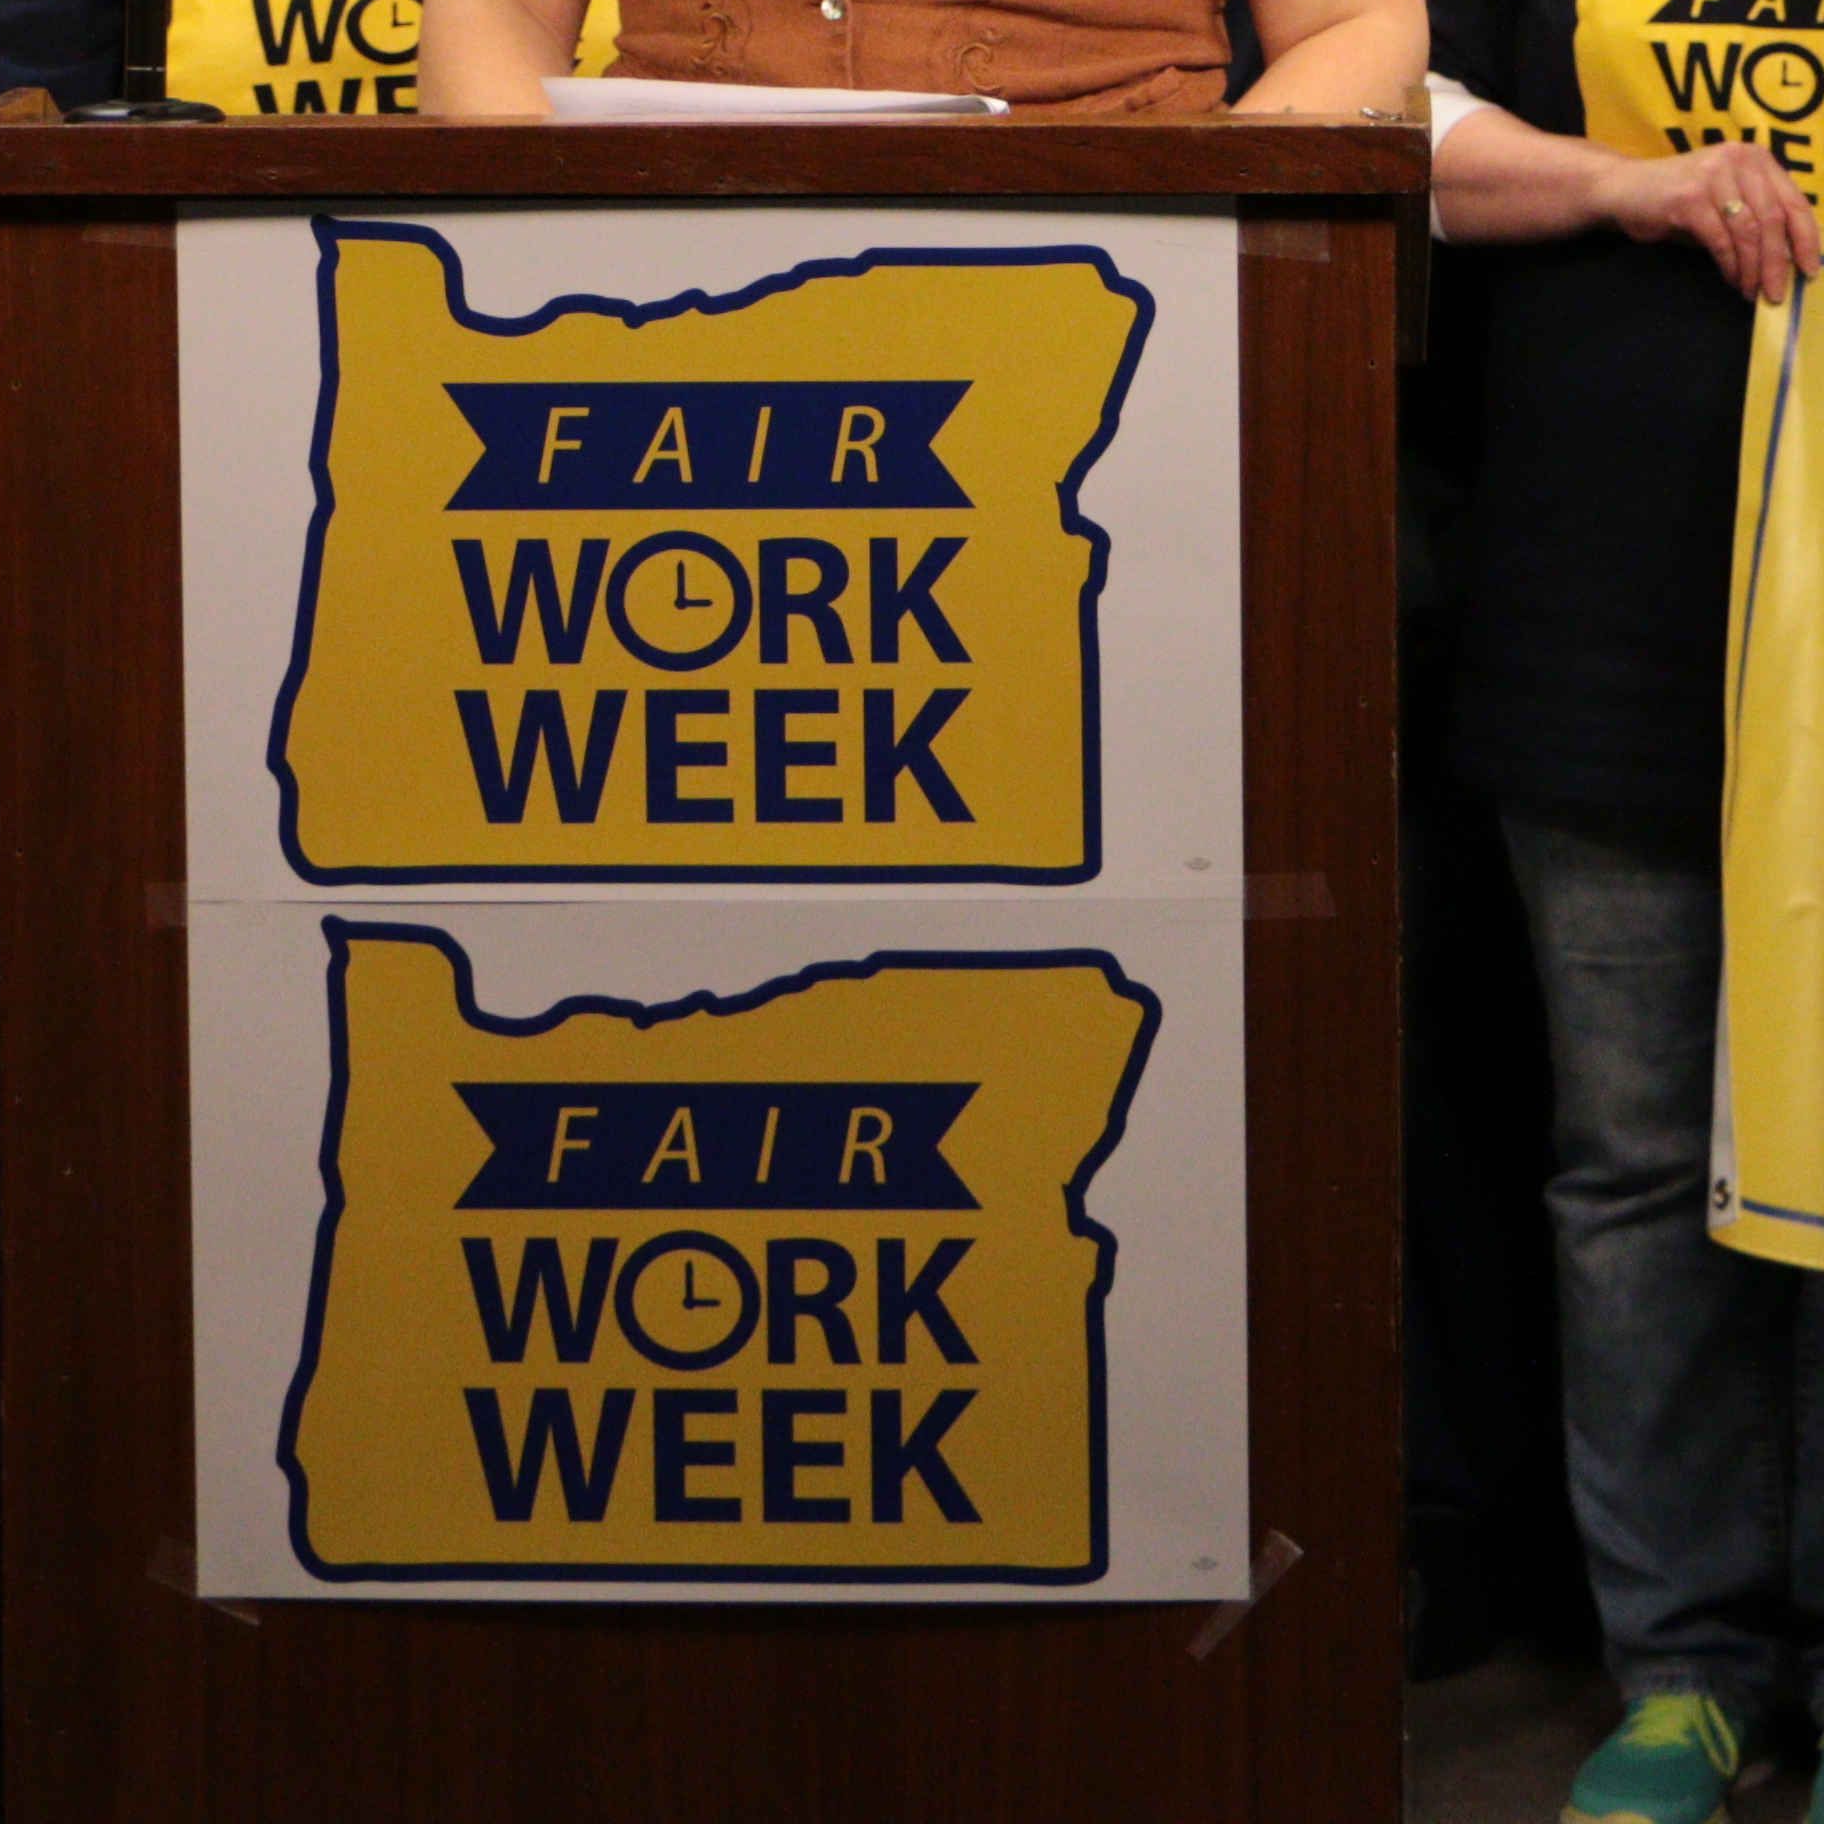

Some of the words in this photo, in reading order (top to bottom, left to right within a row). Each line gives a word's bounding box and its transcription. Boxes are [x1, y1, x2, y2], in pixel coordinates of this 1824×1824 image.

[254, 75, 418, 114] WE
[537, 406, 887, 484] FAIR
[451, 530, 972, 671] WORK
[454, 688, 975, 823] WEEK
[547, 1106, 894, 1184] FAIR
[461, 1230, 980, 1371] WORK
[463, 1387, 983, 1524] WEEK
